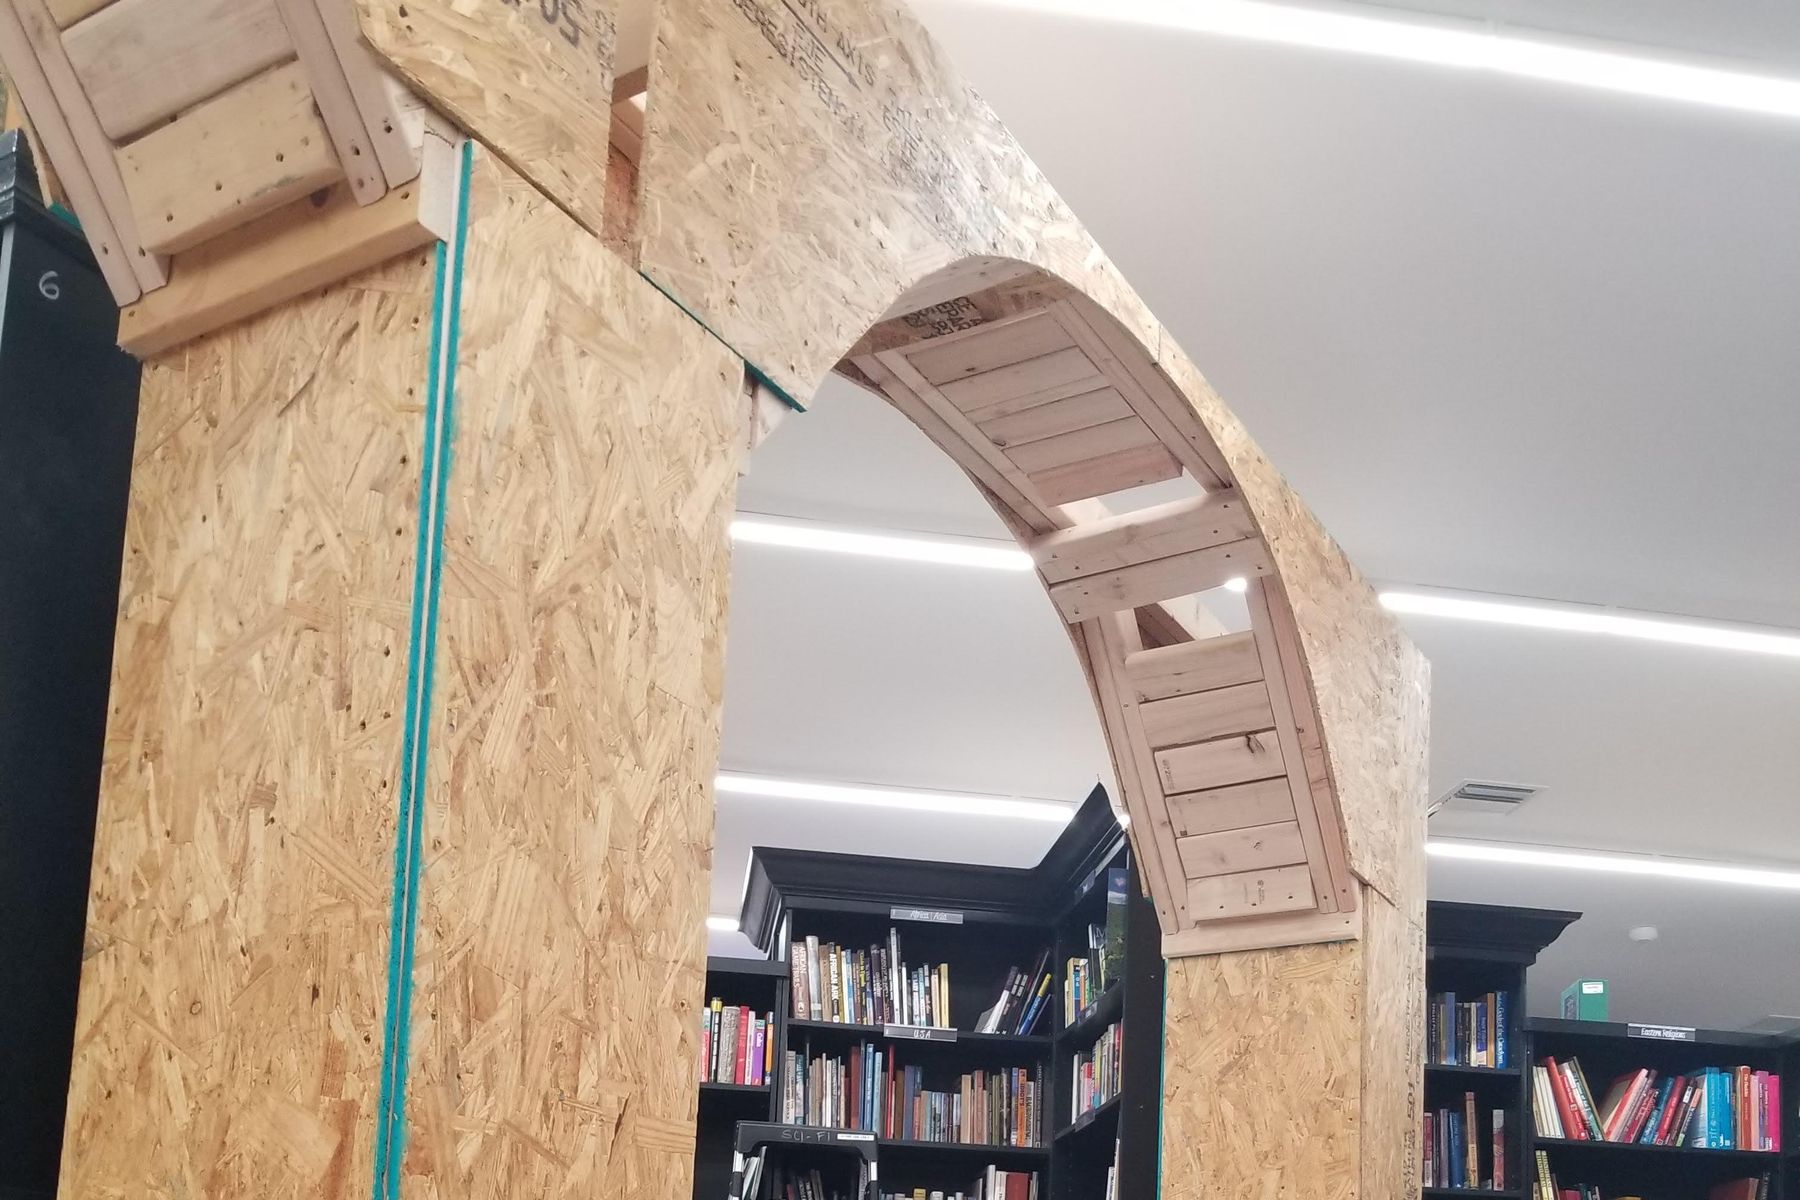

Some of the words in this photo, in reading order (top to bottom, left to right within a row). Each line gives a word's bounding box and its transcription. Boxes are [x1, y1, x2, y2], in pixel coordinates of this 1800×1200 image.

[38, 270, 60, 300] 6
[830, 953, 838, 985] AFRICAN
[831, 985, 839, 1001] ARK
[914, 1029, 931, 1039] USA
